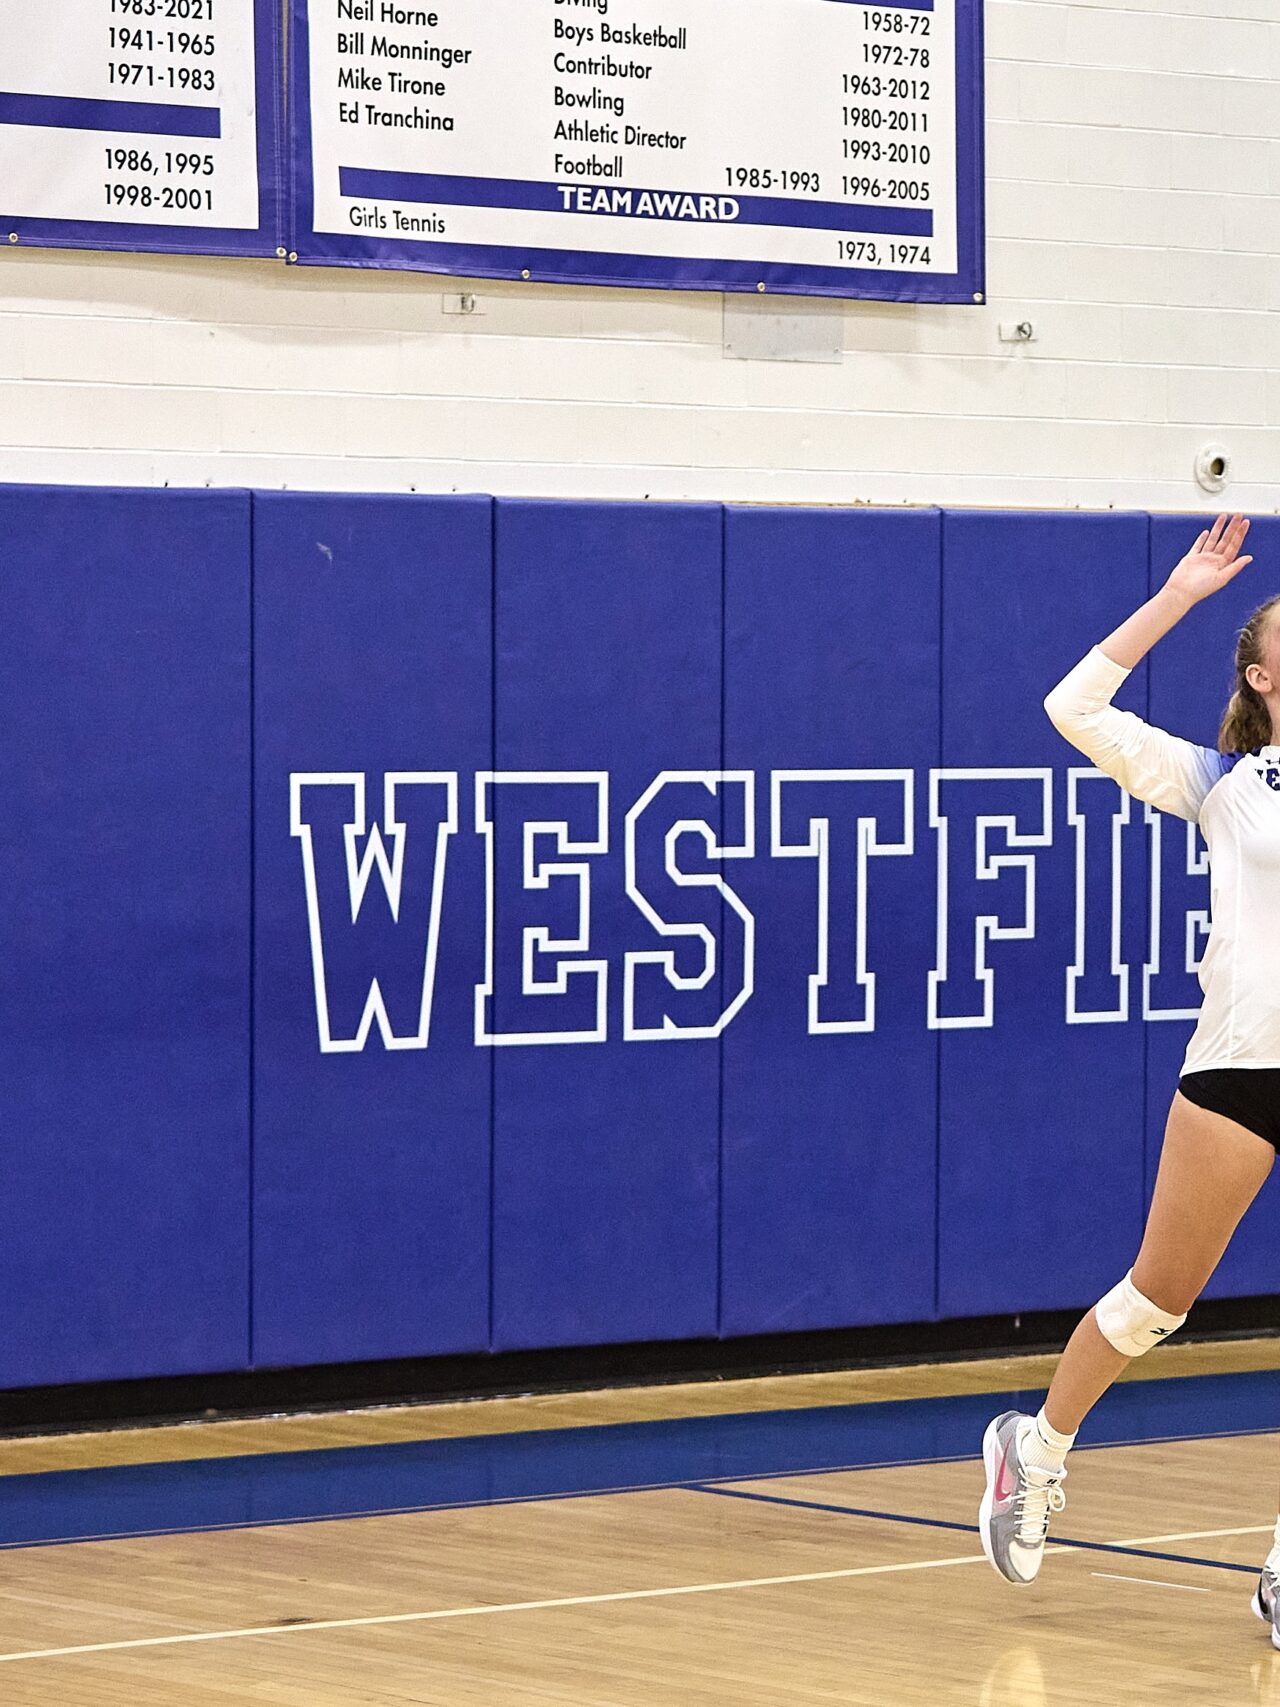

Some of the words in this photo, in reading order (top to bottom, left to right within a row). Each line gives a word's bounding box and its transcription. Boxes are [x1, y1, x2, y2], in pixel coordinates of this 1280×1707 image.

[111, 0, 213, 21] 1983-2021
[337, 0, 373, 22] Neil
[380, 2, 439, 28] Horne
[863, 10, 931, 36] 1958-72
[109, 26, 215, 56] 1941-1965
[554, 18, 594, 47] Boys
[600, 22, 687, 50] Basketball
[337, 32, 364, 55] Bill
[370, 35, 473, 66] Monninger
[863, 43, 931, 69] 1972-78
[108, 62, 216, 92] 1971-1983
[553, 52, 653, 80] Contributor
[337, 67, 382, 92] Mike
[387, 71, 446, 97] Tirone
[842, 73, 931, 101] 1963-2012
[554, 85, 625, 117] Bowling
[339, 102, 359, 124] Ed
[364, 104, 455, 132] Tranchina
[842, 106, 930, 133] 1980-2011
[554, 118, 619, 144] Athletic
[624, 125, 687, 150] Director
[554, 153, 624, 178] Football
[842, 138, 931, 166] 1993-2010
[104, 183, 213, 211] 1998-2001
[725, 166, 820, 193] 1985-1993
[842, 175, 931, 201] 1996-2005
[557, 185, 632, 214] TEAM
[635, 191, 740, 221] AWARD
[349, 206, 388, 230] Girls
[392, 209, 446, 234] Tennis
[837, 239, 882, 266] 1973,
[889, 243, 931, 265] 1974
